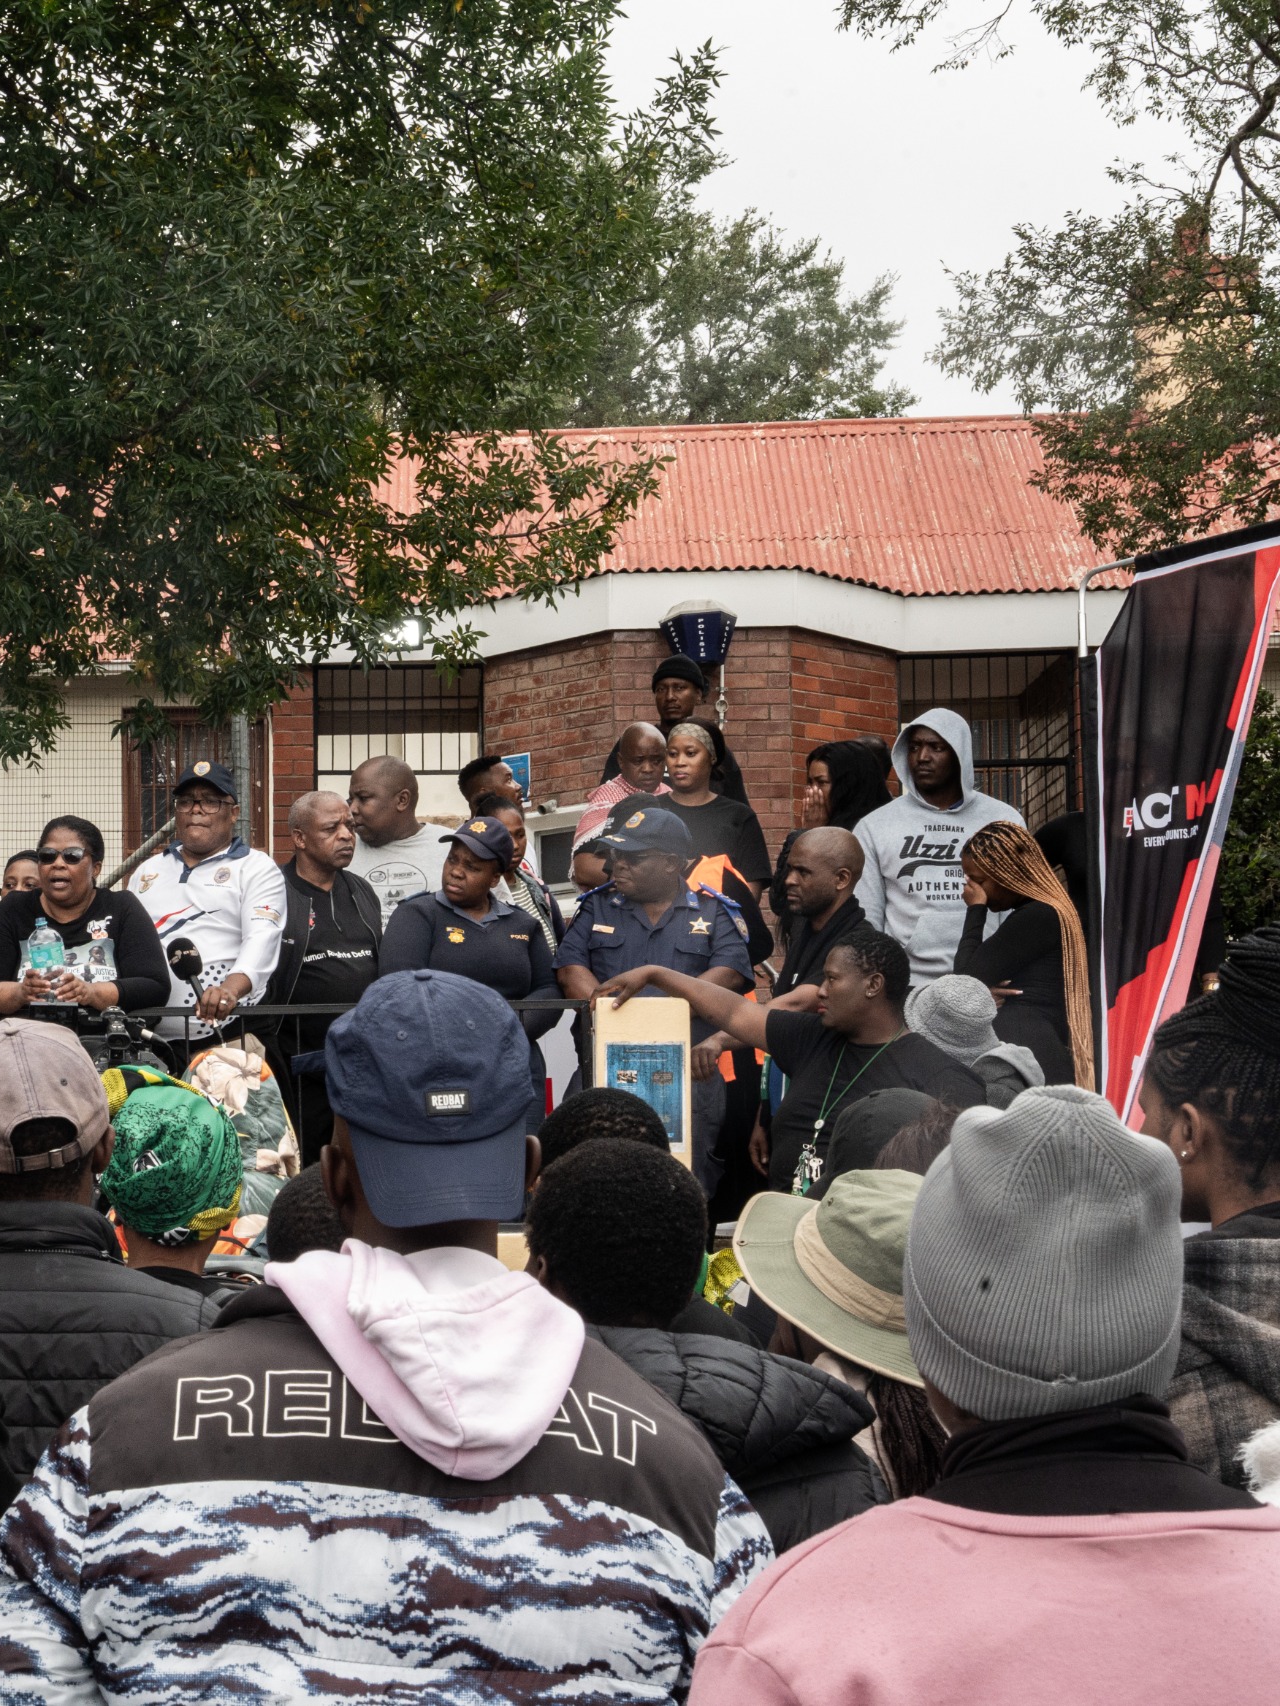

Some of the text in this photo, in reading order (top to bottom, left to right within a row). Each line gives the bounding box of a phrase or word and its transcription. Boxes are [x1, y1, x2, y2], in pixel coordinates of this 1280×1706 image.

[697, 618, 706, 657] POLISIE
[924, 824, 965, 833] TRADEMARK
[1165, 828, 1190, 841] OUNTS.
[899, 834, 960, 860] Uzzi
[431, 1093, 465, 1106] REDBAT
